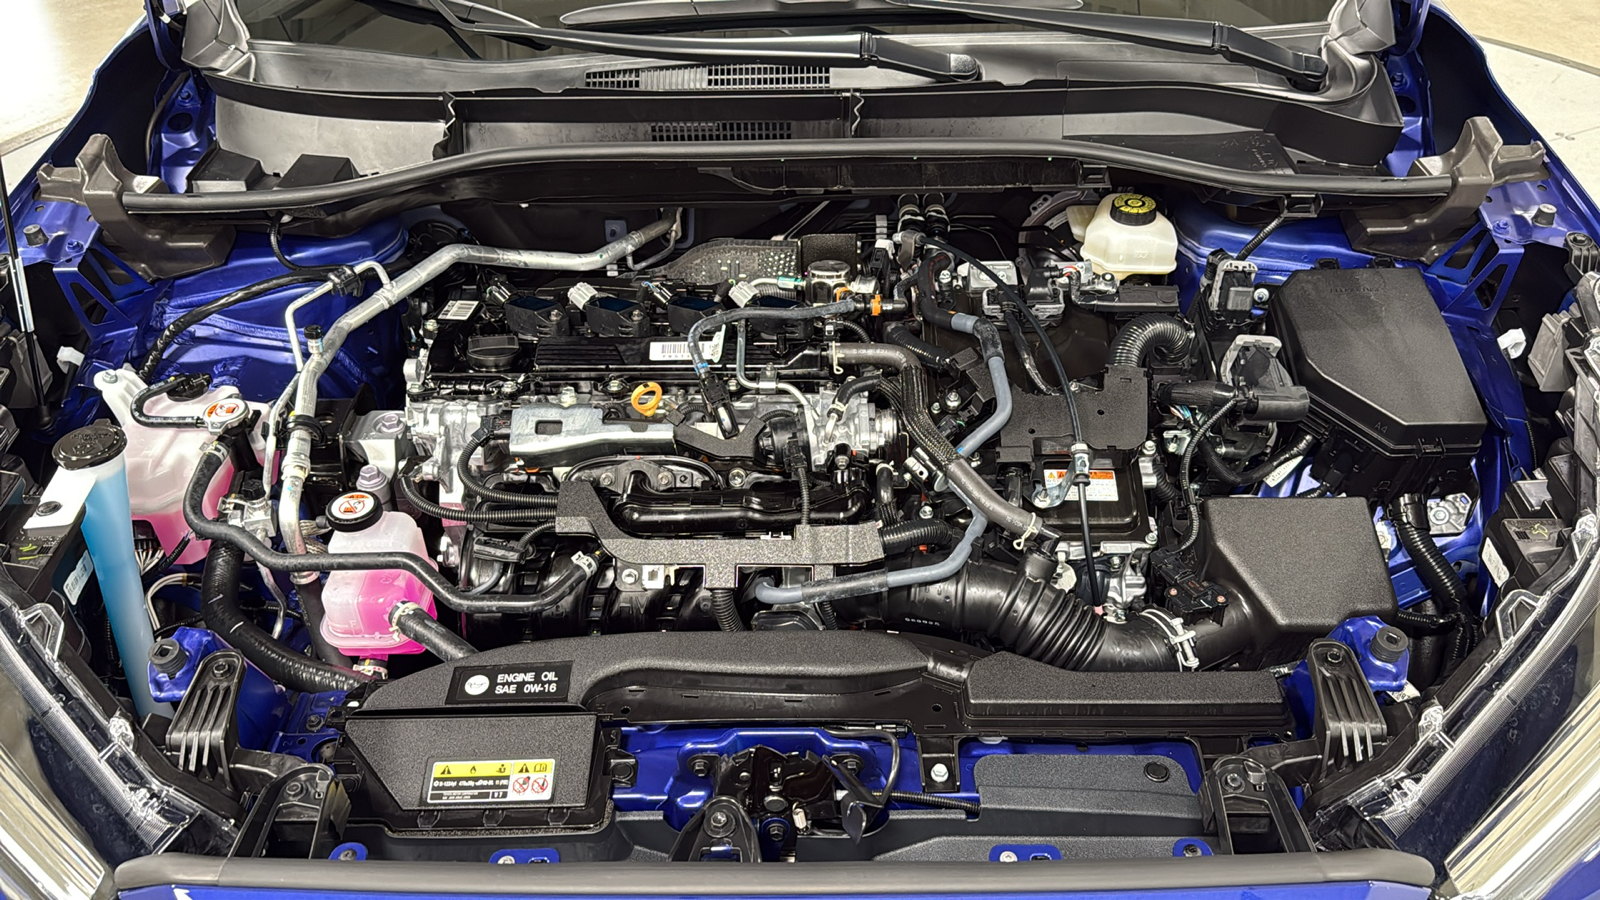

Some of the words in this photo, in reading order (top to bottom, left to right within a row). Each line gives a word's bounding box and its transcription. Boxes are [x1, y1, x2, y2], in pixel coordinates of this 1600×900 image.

[1374, 421, 1388, 433] A4
[497, 672, 535, 683] ENGINE
[541, 671, 558, 681] OIL
[495, 684, 517, 694] SAE
[523, 683, 557, 693] 0W-16
